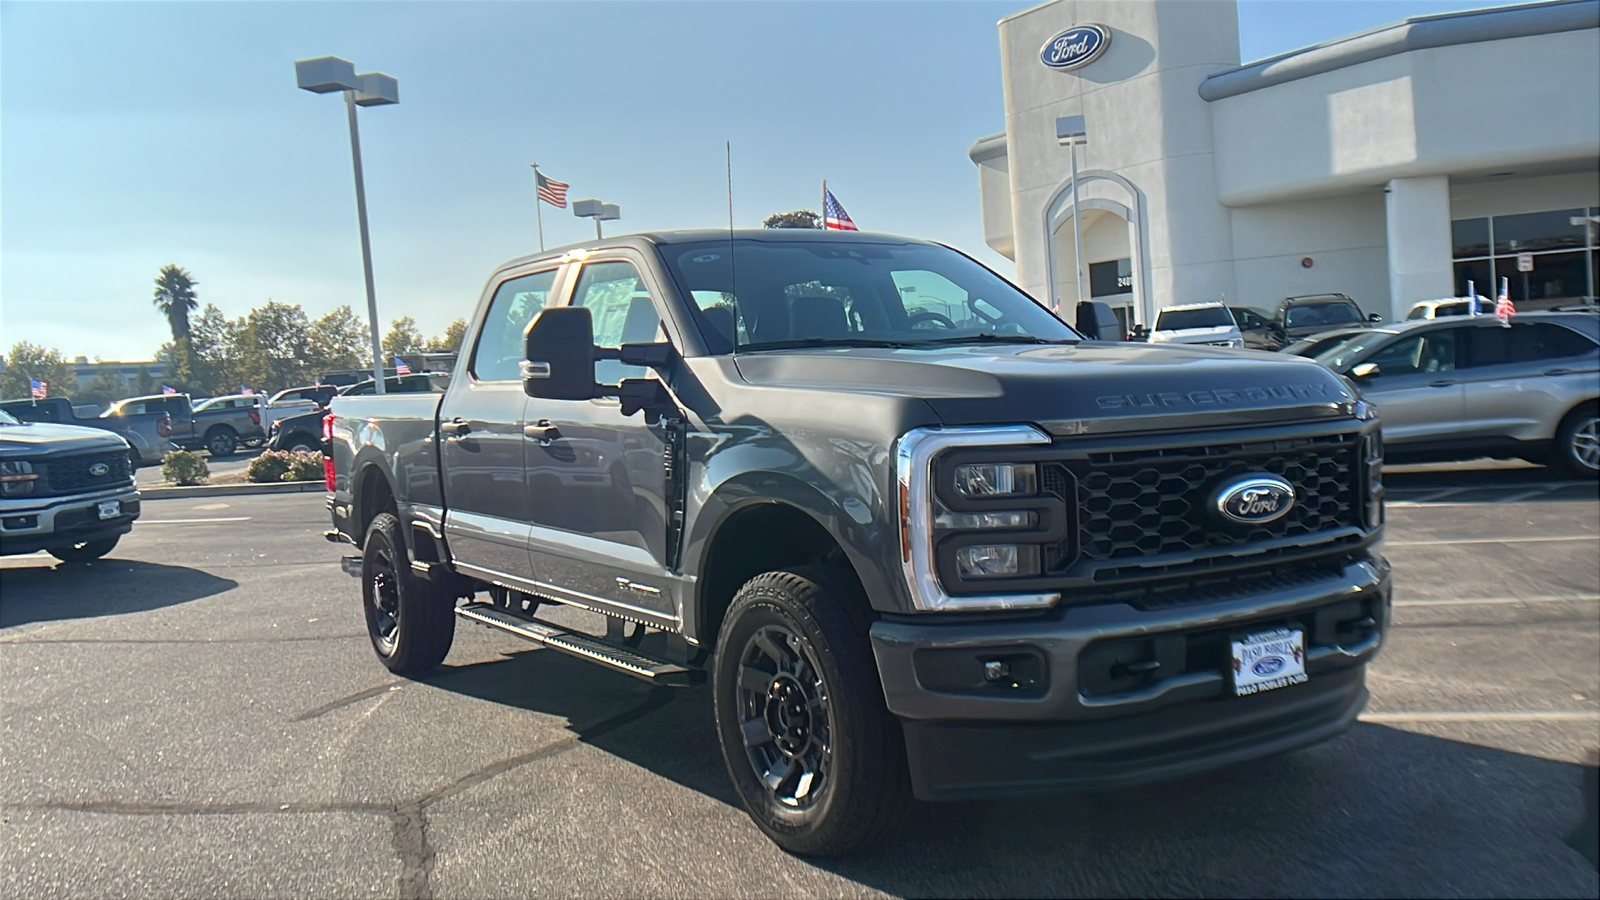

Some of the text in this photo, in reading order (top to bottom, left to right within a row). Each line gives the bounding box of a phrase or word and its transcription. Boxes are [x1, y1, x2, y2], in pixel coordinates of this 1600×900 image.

[1051, 33, 1089, 62] Ford
[1239, 488, 1280, 515] Ford
[1241, 646, 1263, 665] PASO
